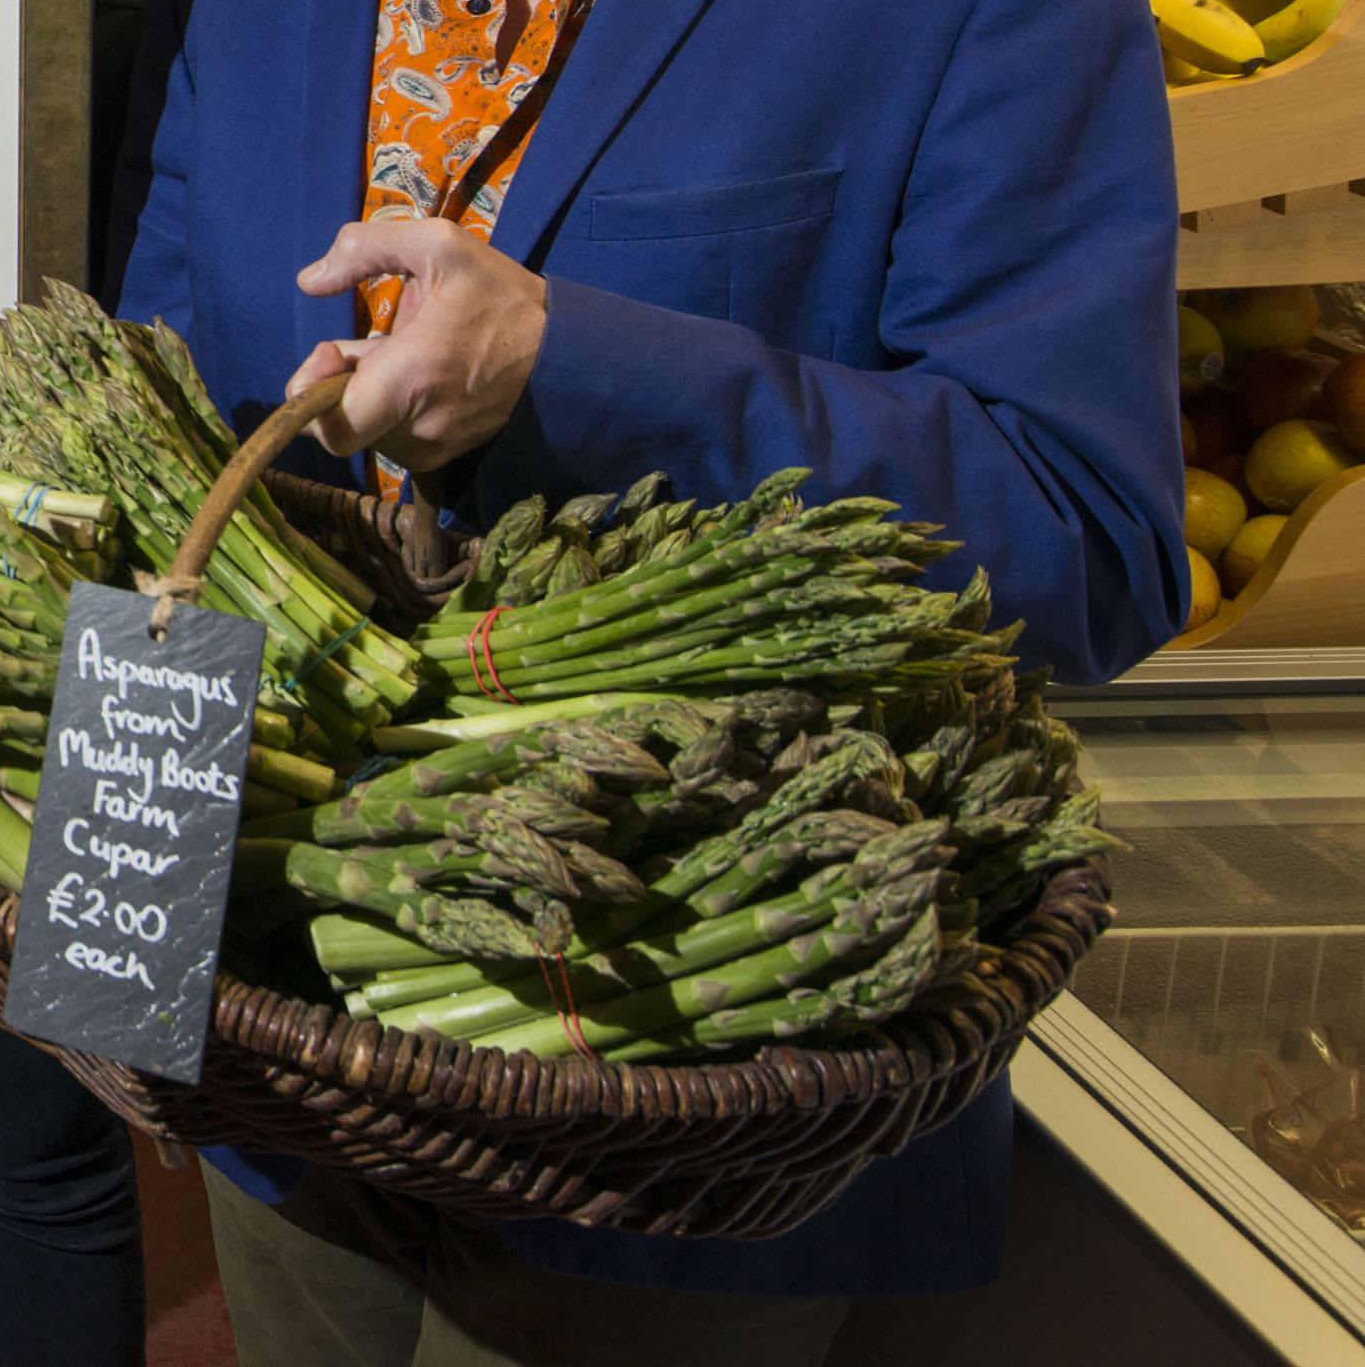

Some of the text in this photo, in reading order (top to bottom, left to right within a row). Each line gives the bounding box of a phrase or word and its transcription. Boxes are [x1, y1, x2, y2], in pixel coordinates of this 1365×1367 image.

[77, 628, 238, 731] Asparagus
[101, 694, 185, 741] from
[58, 728, 240, 803] Muddy Boots
[94, 780, 180, 837] Farm
[63, 817, 180, 879] Cupar
[65, 940, 156, 991] each
